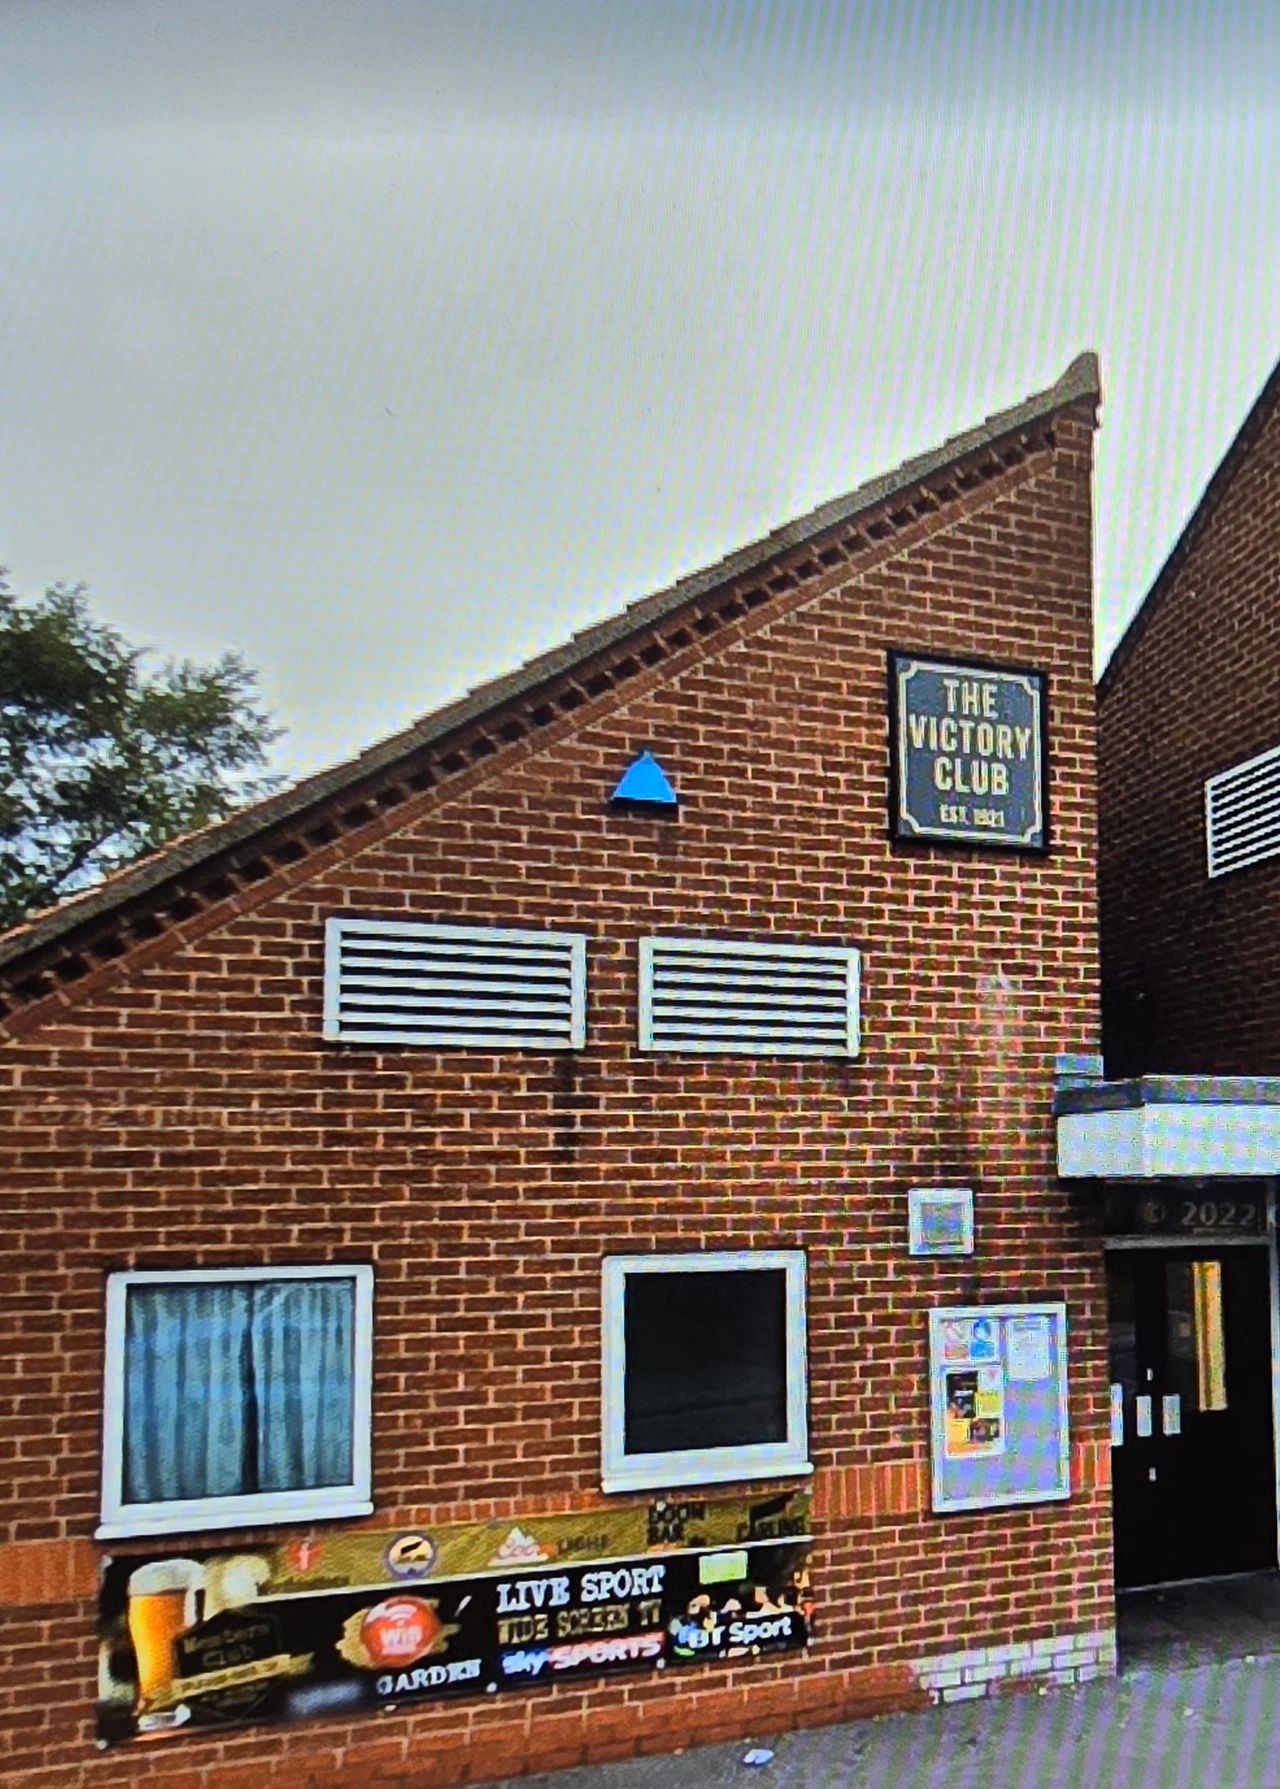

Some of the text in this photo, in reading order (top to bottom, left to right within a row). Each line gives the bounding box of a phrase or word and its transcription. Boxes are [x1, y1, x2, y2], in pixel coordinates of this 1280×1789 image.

[943, 678, 999, 720] THE
[909, 714, 1031, 761] VICTORY
[934, 756, 1010, 796] CLUB
[496, 1564, 666, 1614] LIVE SPORT
[729, 1616, 792, 1644] Sport
[553, 1635, 662, 1669] SPORTS
[377, 1658, 482, 1695] GARDEN
